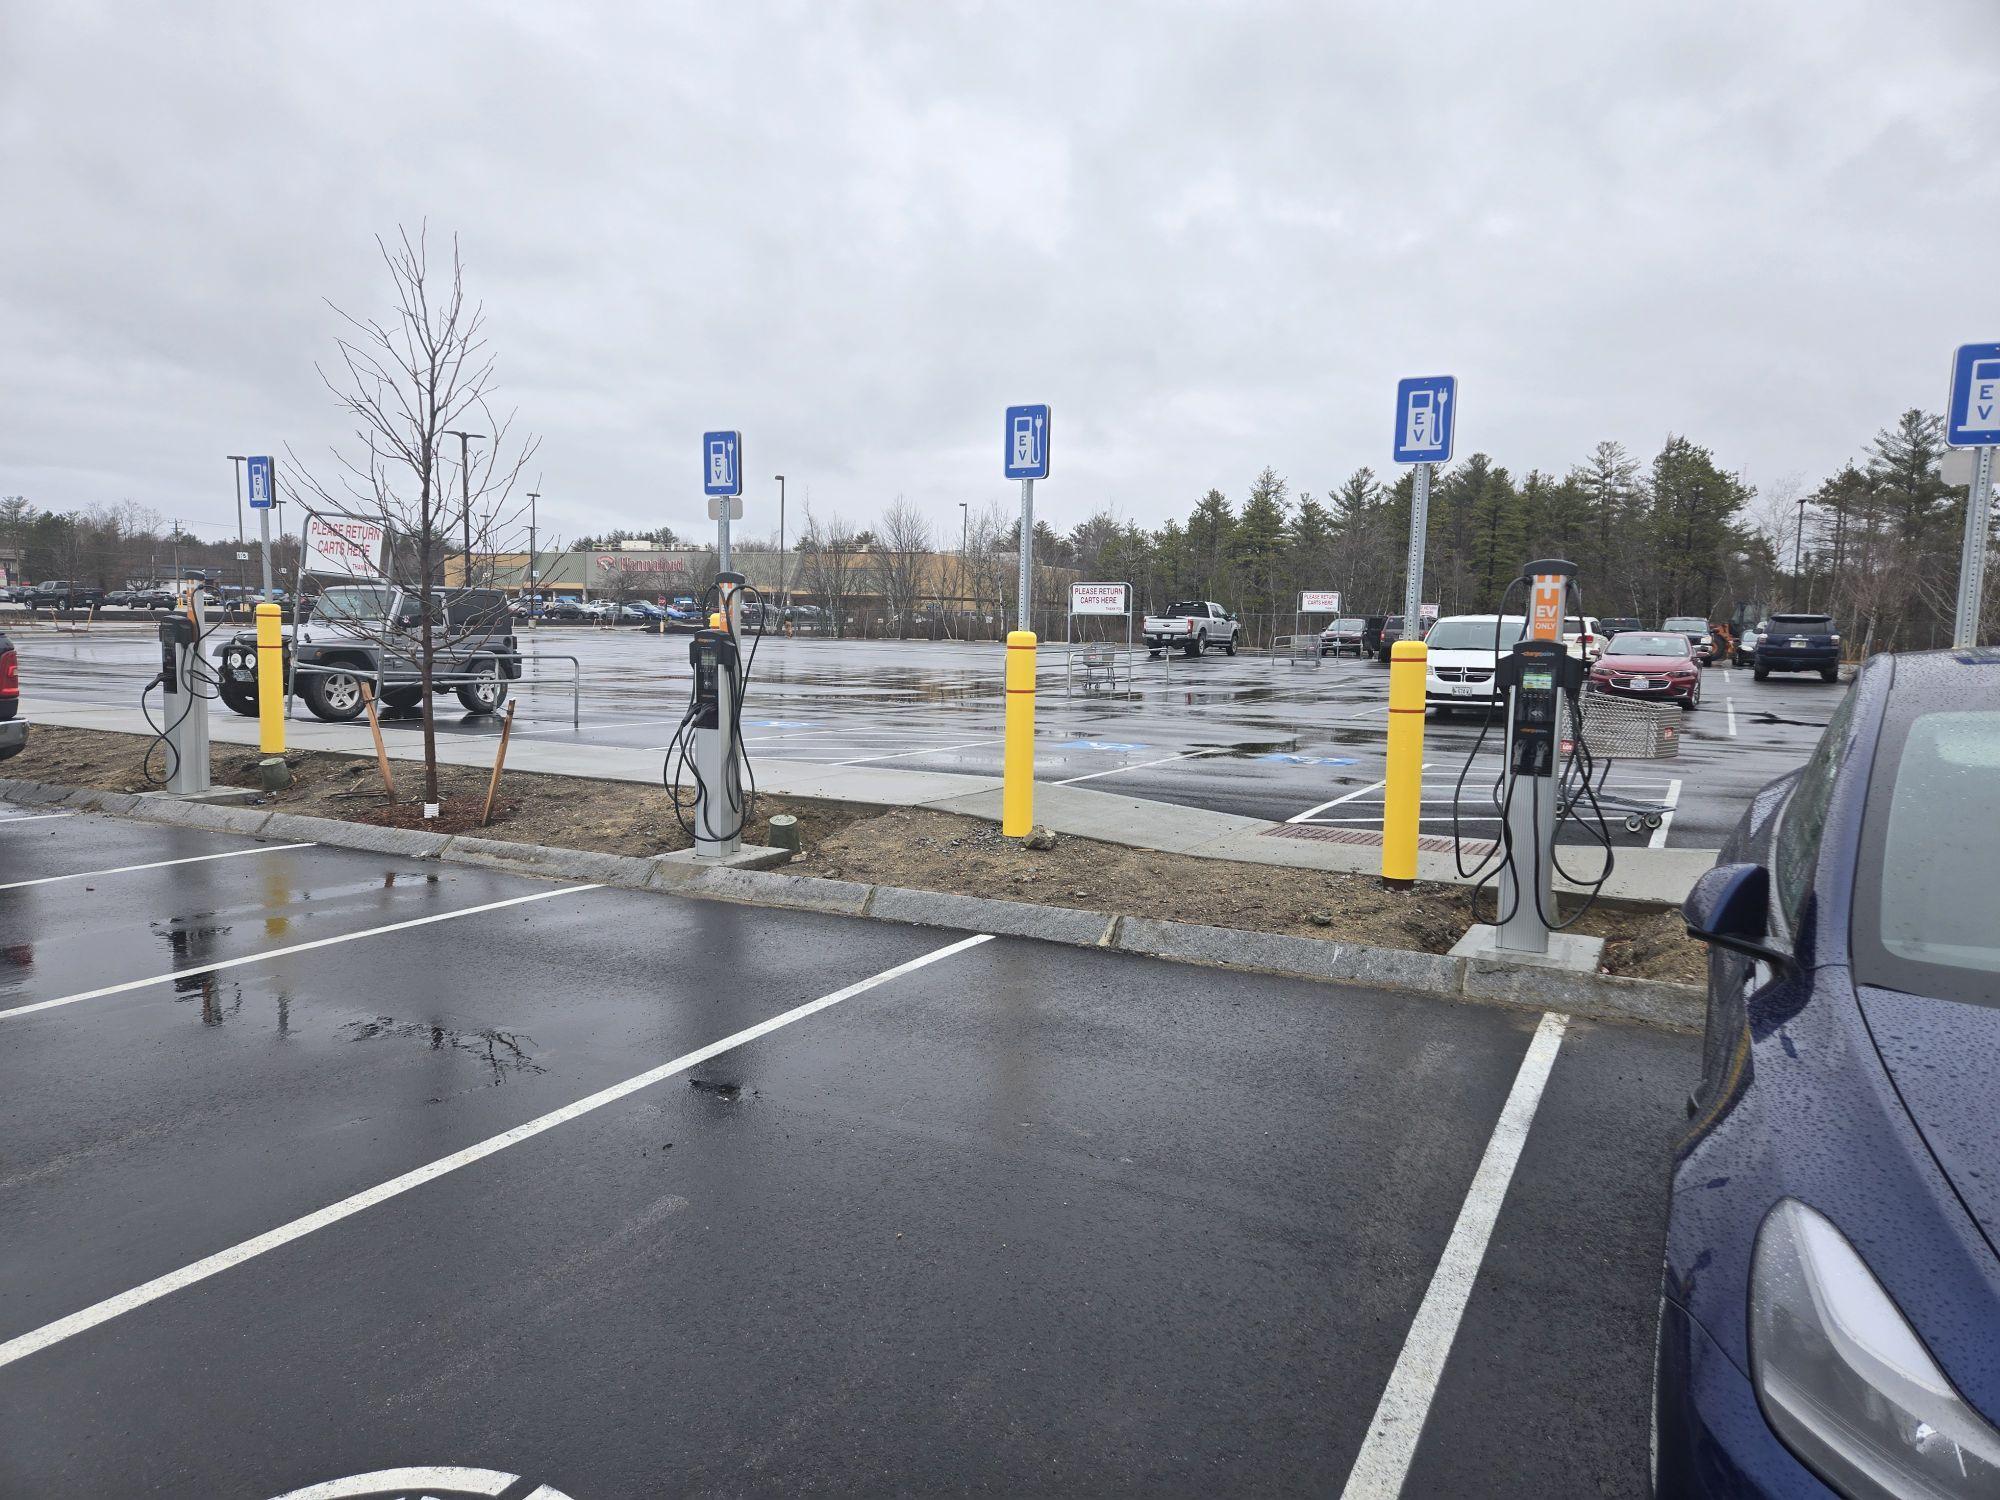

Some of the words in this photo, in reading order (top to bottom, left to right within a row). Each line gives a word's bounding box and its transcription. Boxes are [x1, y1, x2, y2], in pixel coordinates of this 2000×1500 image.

[1977, 384, 1994, 420] EV
[1413, 412, 1425, 442] EV
[1019, 435, 1027, 461] EV
[714, 457, 722, 480] EV
[311, 521, 343, 537] PLEASE
[345, 524, 381, 541] RETURN
[317, 540, 345, 556] CARTS
[1074, 587, 1098, 595] PLEASE
[1098, 587, 1123, 595] RETURN
[1080, 596, 1100, 604] CARTS
[1100, 596, 1117, 604] HERE
[1536, 605, 1558, 618] EV
[1535, 622, 1557, 630] ONLY
